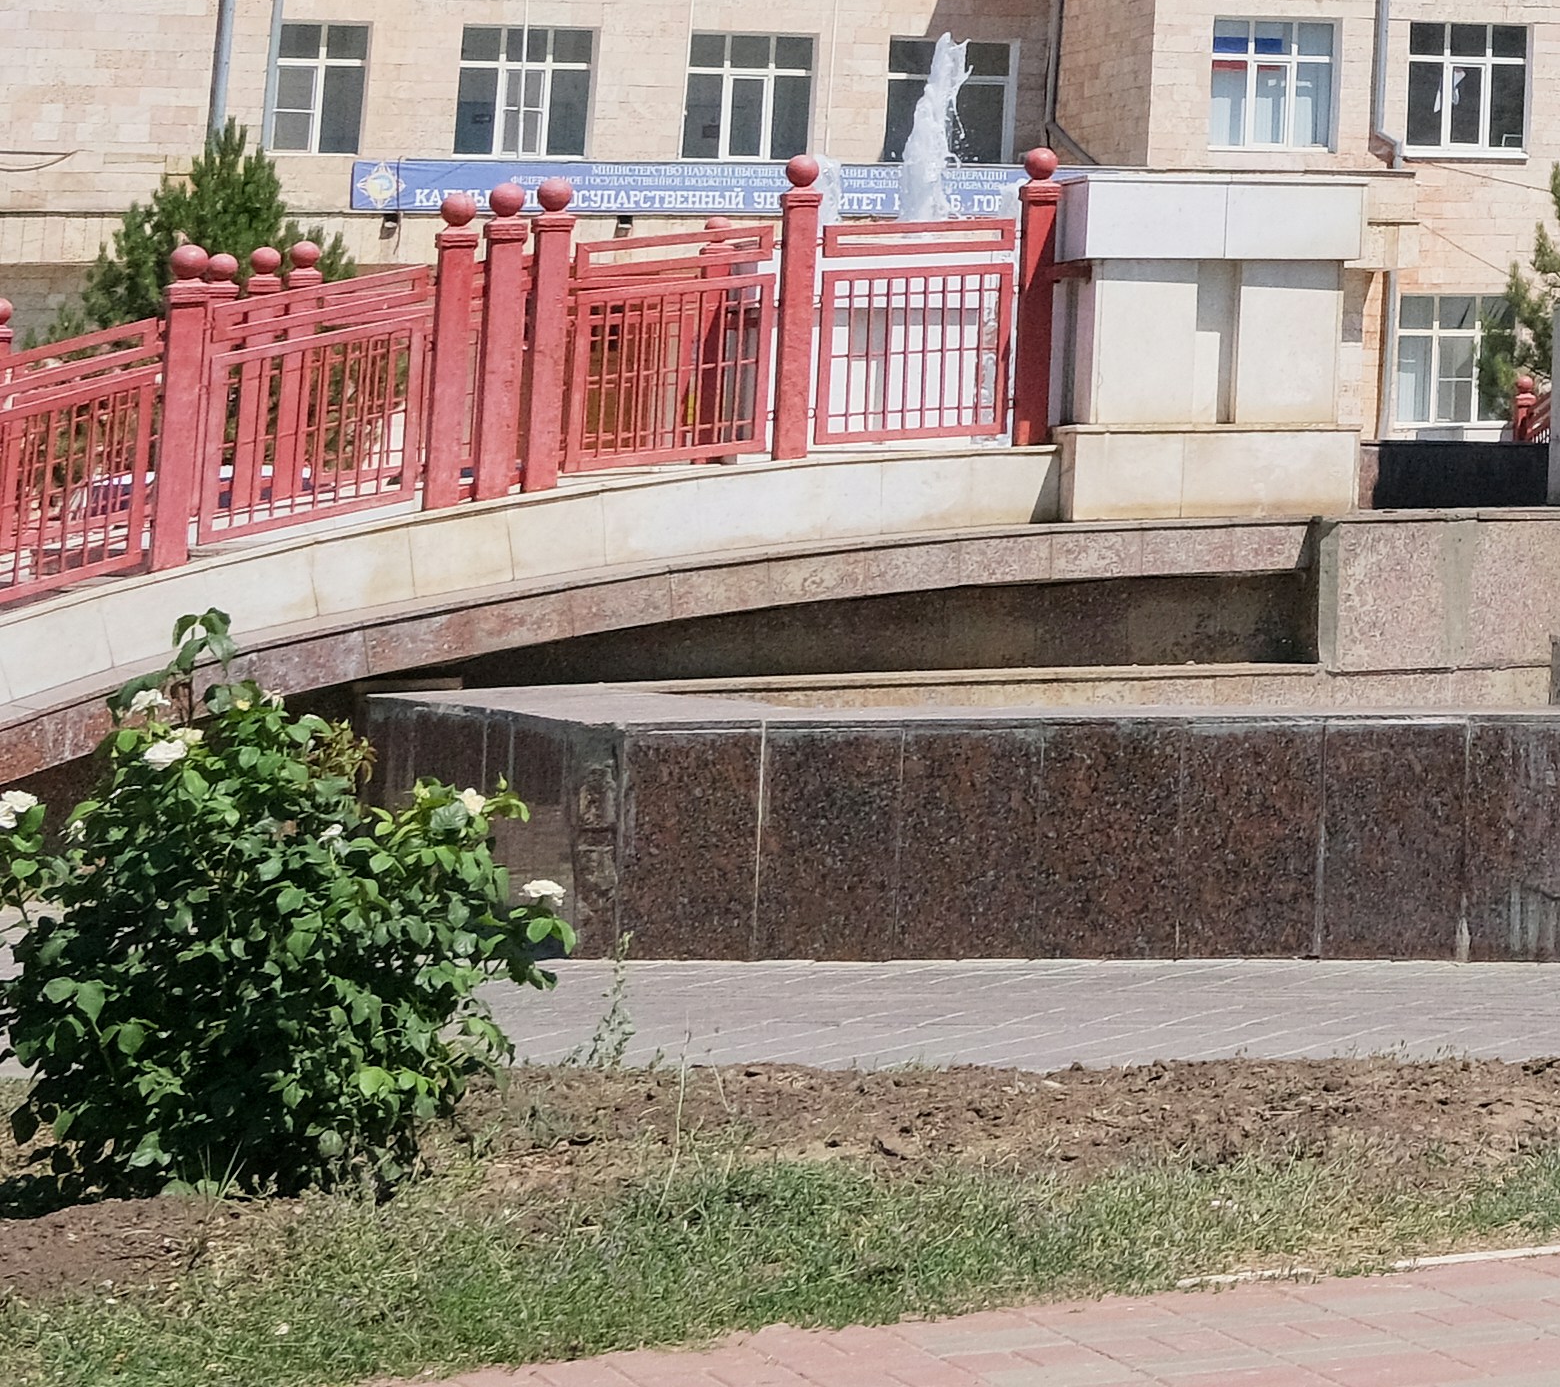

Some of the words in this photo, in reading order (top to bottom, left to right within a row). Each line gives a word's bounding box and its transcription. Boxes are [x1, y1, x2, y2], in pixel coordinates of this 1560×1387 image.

[591, 165, 682, 176] МИНИСТЕРСТВО
[585, 176, 682, 187] ГОСУДАРСТВЕННОЕ
[568, 187, 745, 210] ОСУДАРСТВЕННЫЙ
